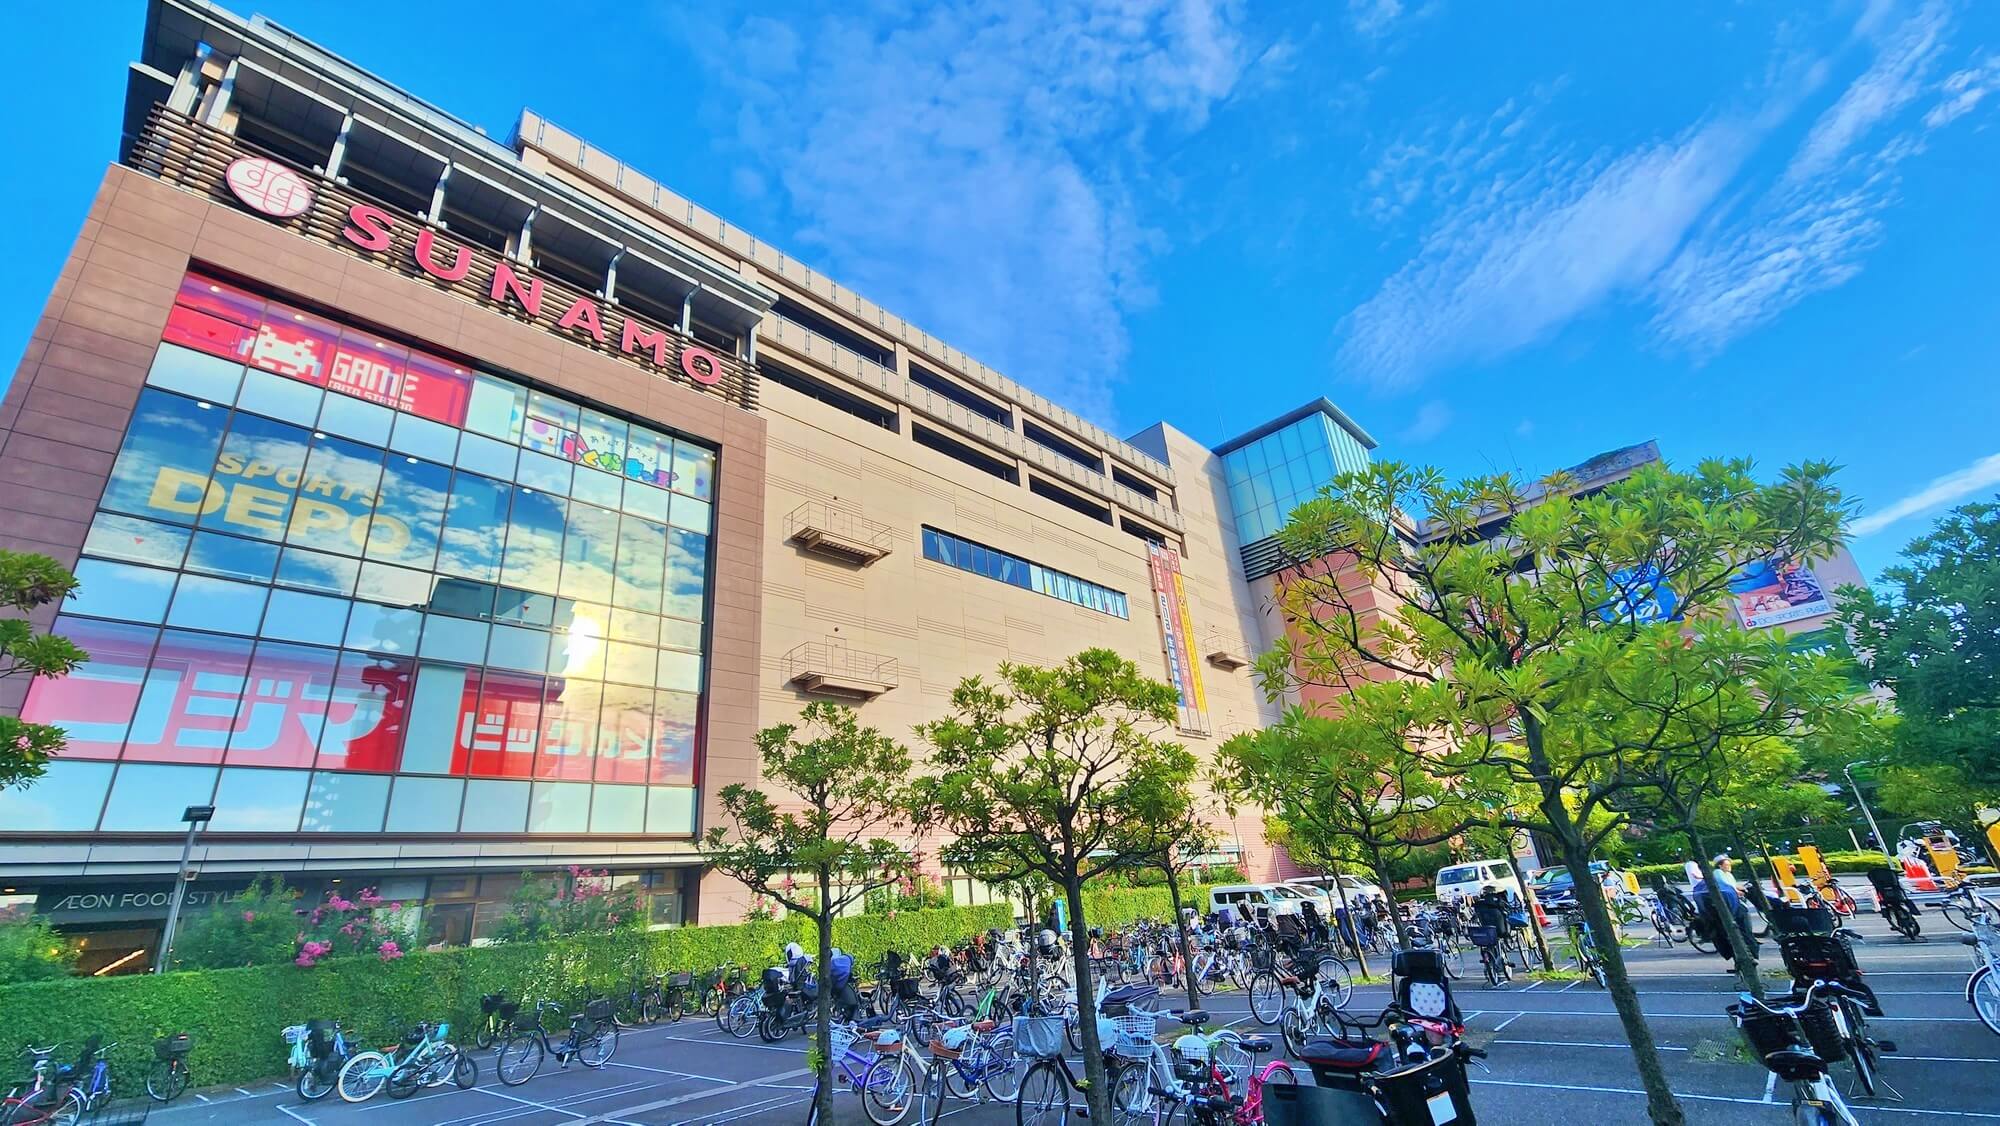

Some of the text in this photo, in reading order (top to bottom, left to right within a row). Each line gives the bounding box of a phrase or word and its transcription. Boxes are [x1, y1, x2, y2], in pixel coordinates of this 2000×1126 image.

[343, 204, 722, 385] SUNAMO
[330, 351, 420, 404] GAME
[148, 466, 412, 554] DEPO
[215, 453, 385, 508] SPORTS
[52, 661, 386, 756] コジマ
[460, 711, 689, 762] ビックカメラ
